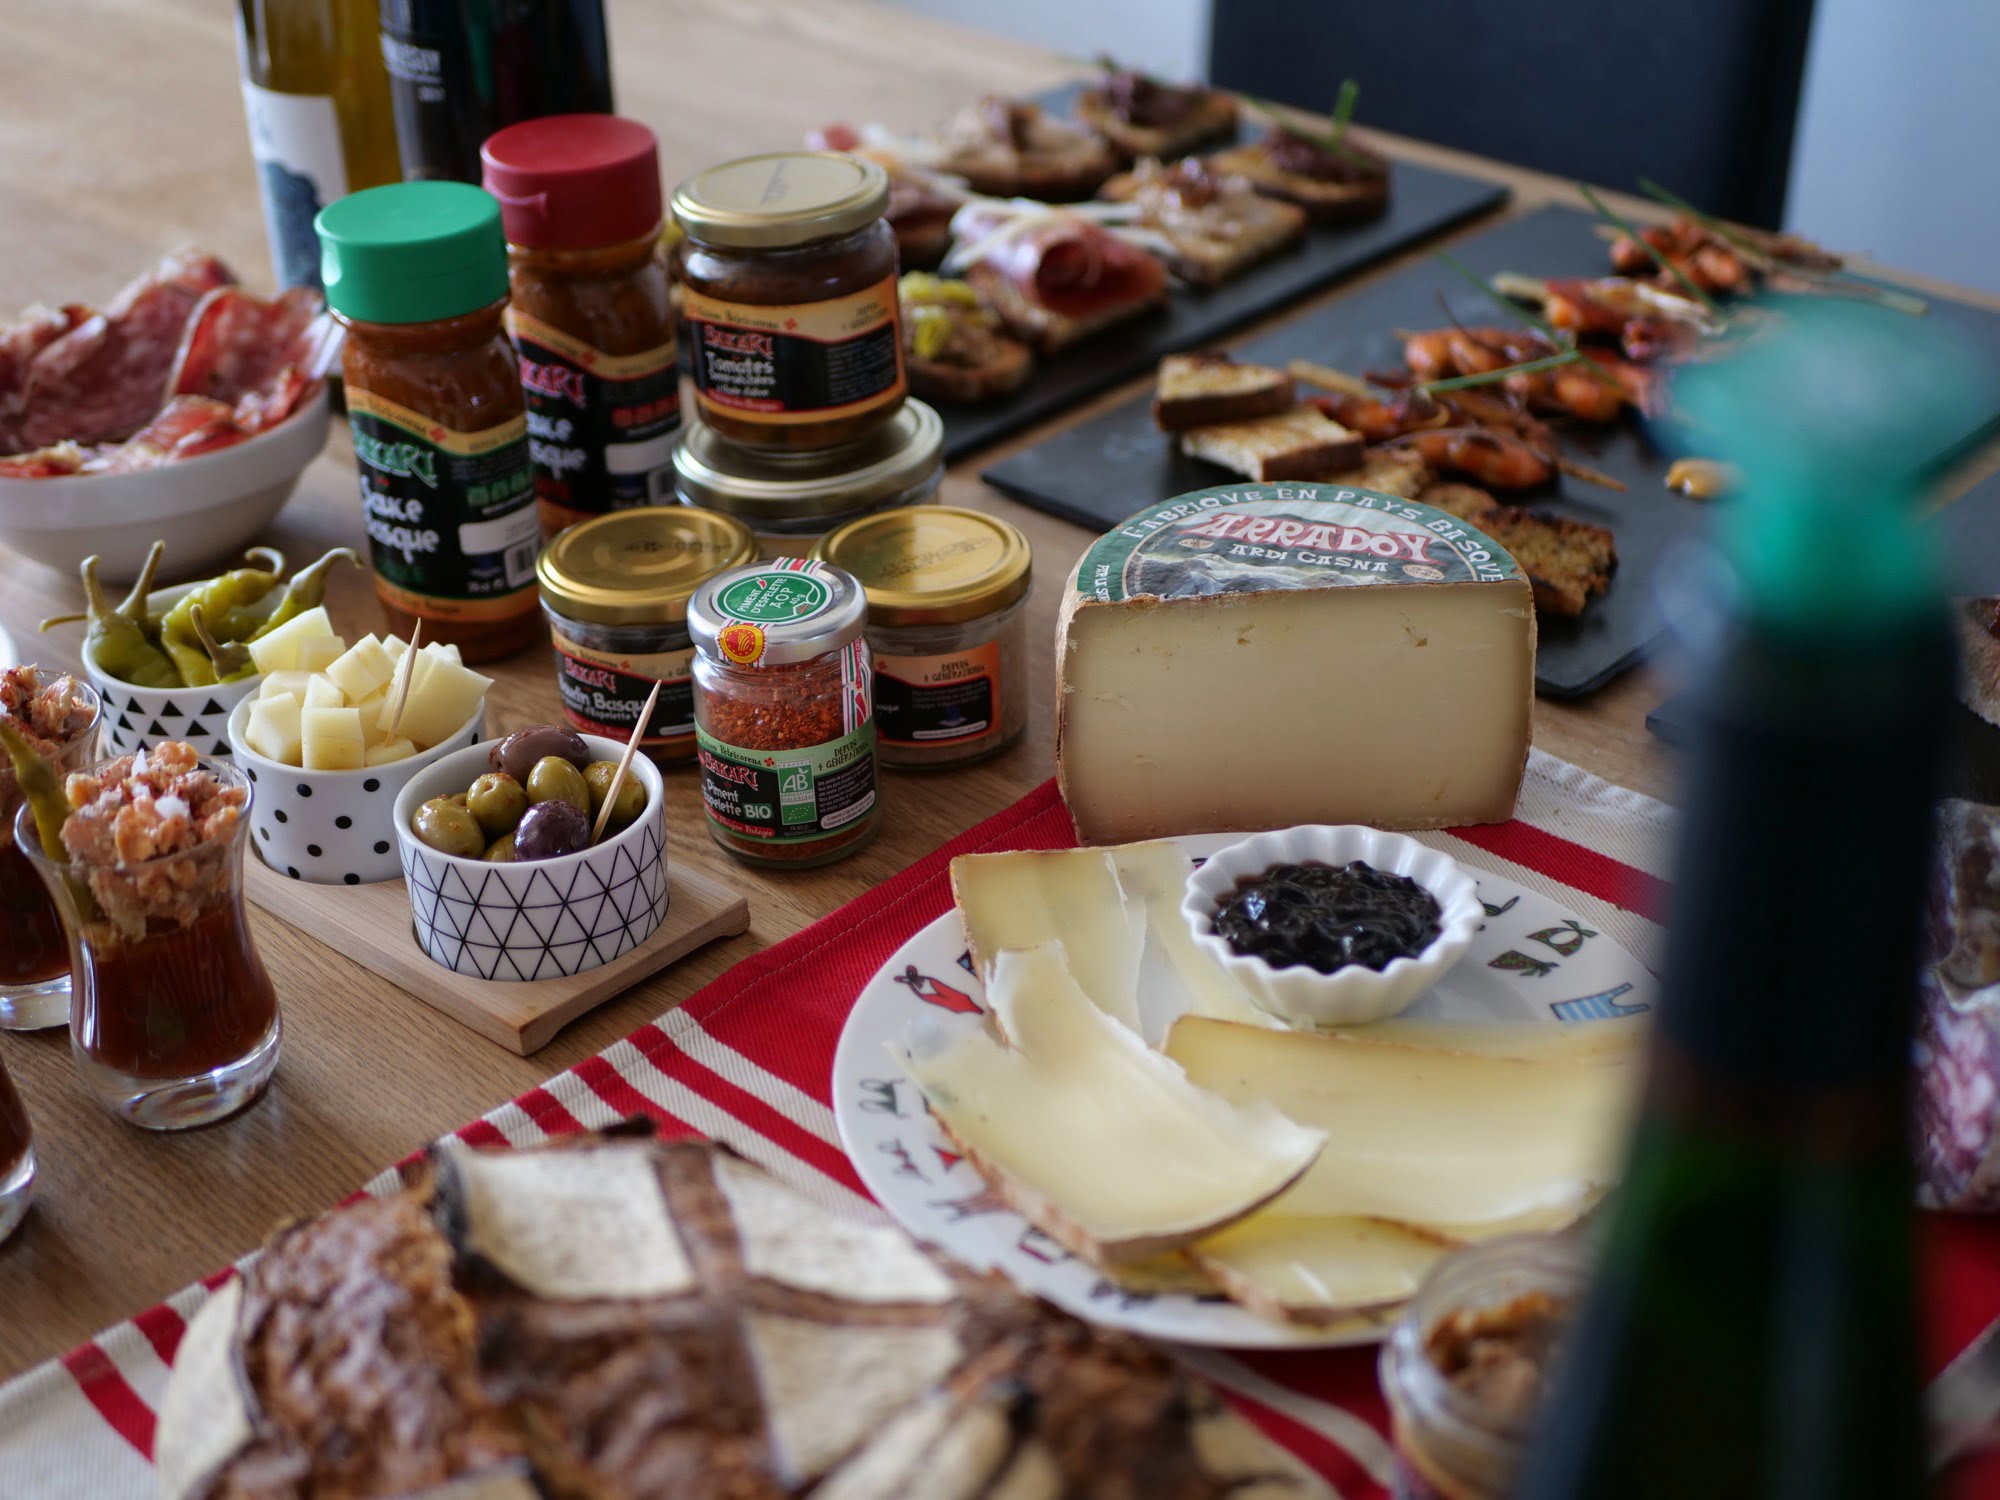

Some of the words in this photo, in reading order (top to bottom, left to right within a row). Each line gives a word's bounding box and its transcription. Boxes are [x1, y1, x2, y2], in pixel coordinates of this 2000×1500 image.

[1277, 487, 1318, 500] EN
[1334, 490, 1423, 520] PAYS
[1187, 513, 1432, 562] ARRADOY
[1297, 551, 1388, 572] GASNA
[737, 589, 762, 612] PIMENT
[750, 577, 788, 613] D'ESPELETTE
[769, 587, 793, 608] AOP
[592, 692, 648, 719] Basqu
[834, 739, 857, 757] DEPUIS
[704, 750, 758, 791] SAKARI
[783, 773, 809, 792] AB
[706, 777, 739, 802] Piment
[744, 804, 773, 819] BIO
